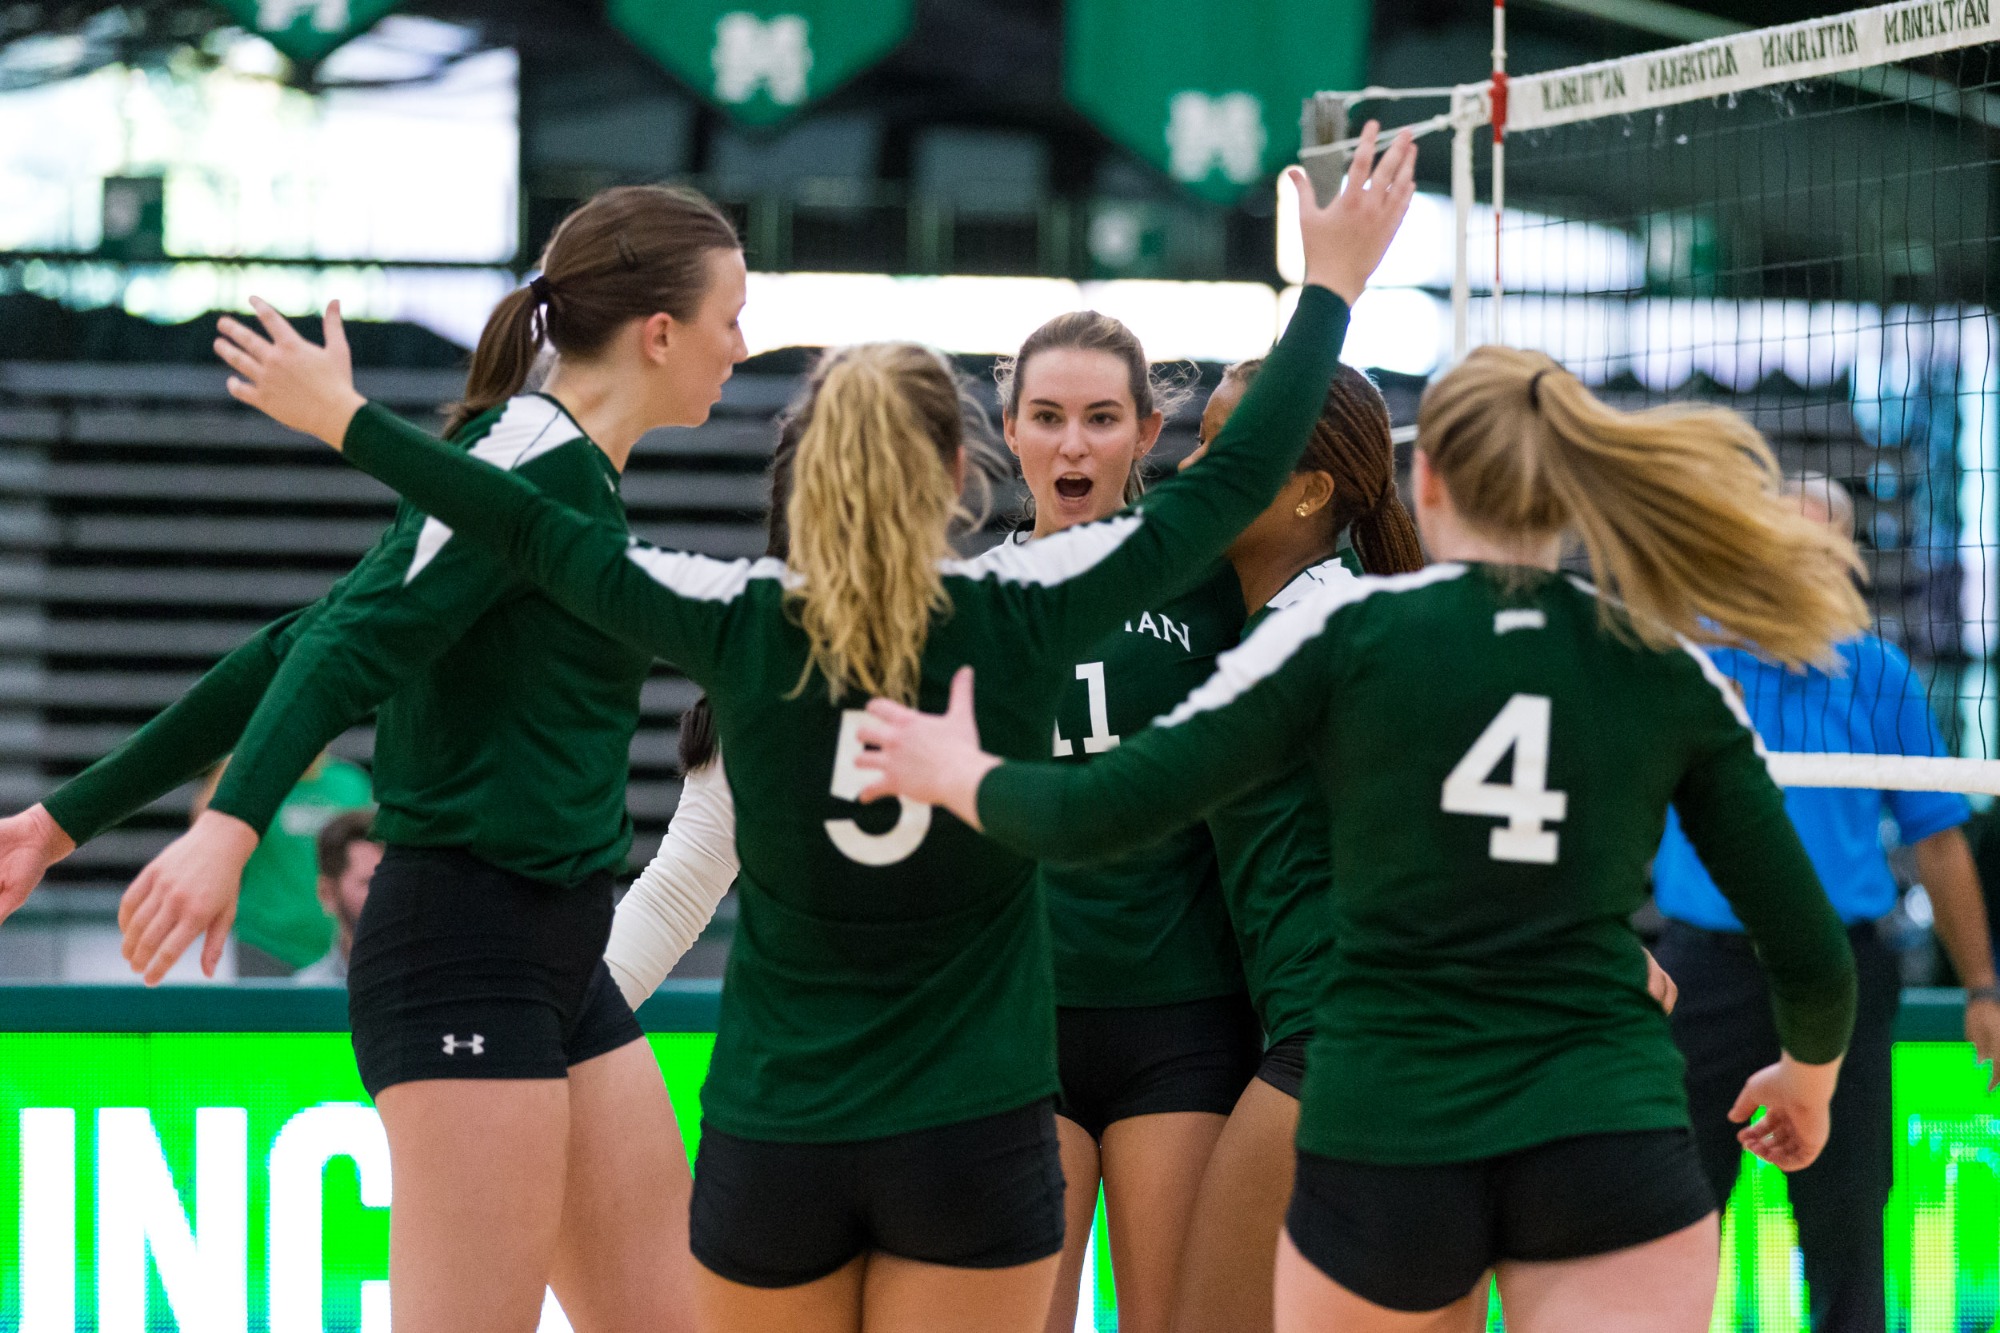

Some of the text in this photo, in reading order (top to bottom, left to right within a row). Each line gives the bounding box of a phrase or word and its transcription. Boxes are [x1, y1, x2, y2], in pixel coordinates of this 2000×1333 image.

[1759, 17, 1859, 68] MANHATTAN
[1884, 0, 1990, 46] MANHATTAN
[824, 709, 932, 866] 5
[1441, 693, 1567, 863] 4
